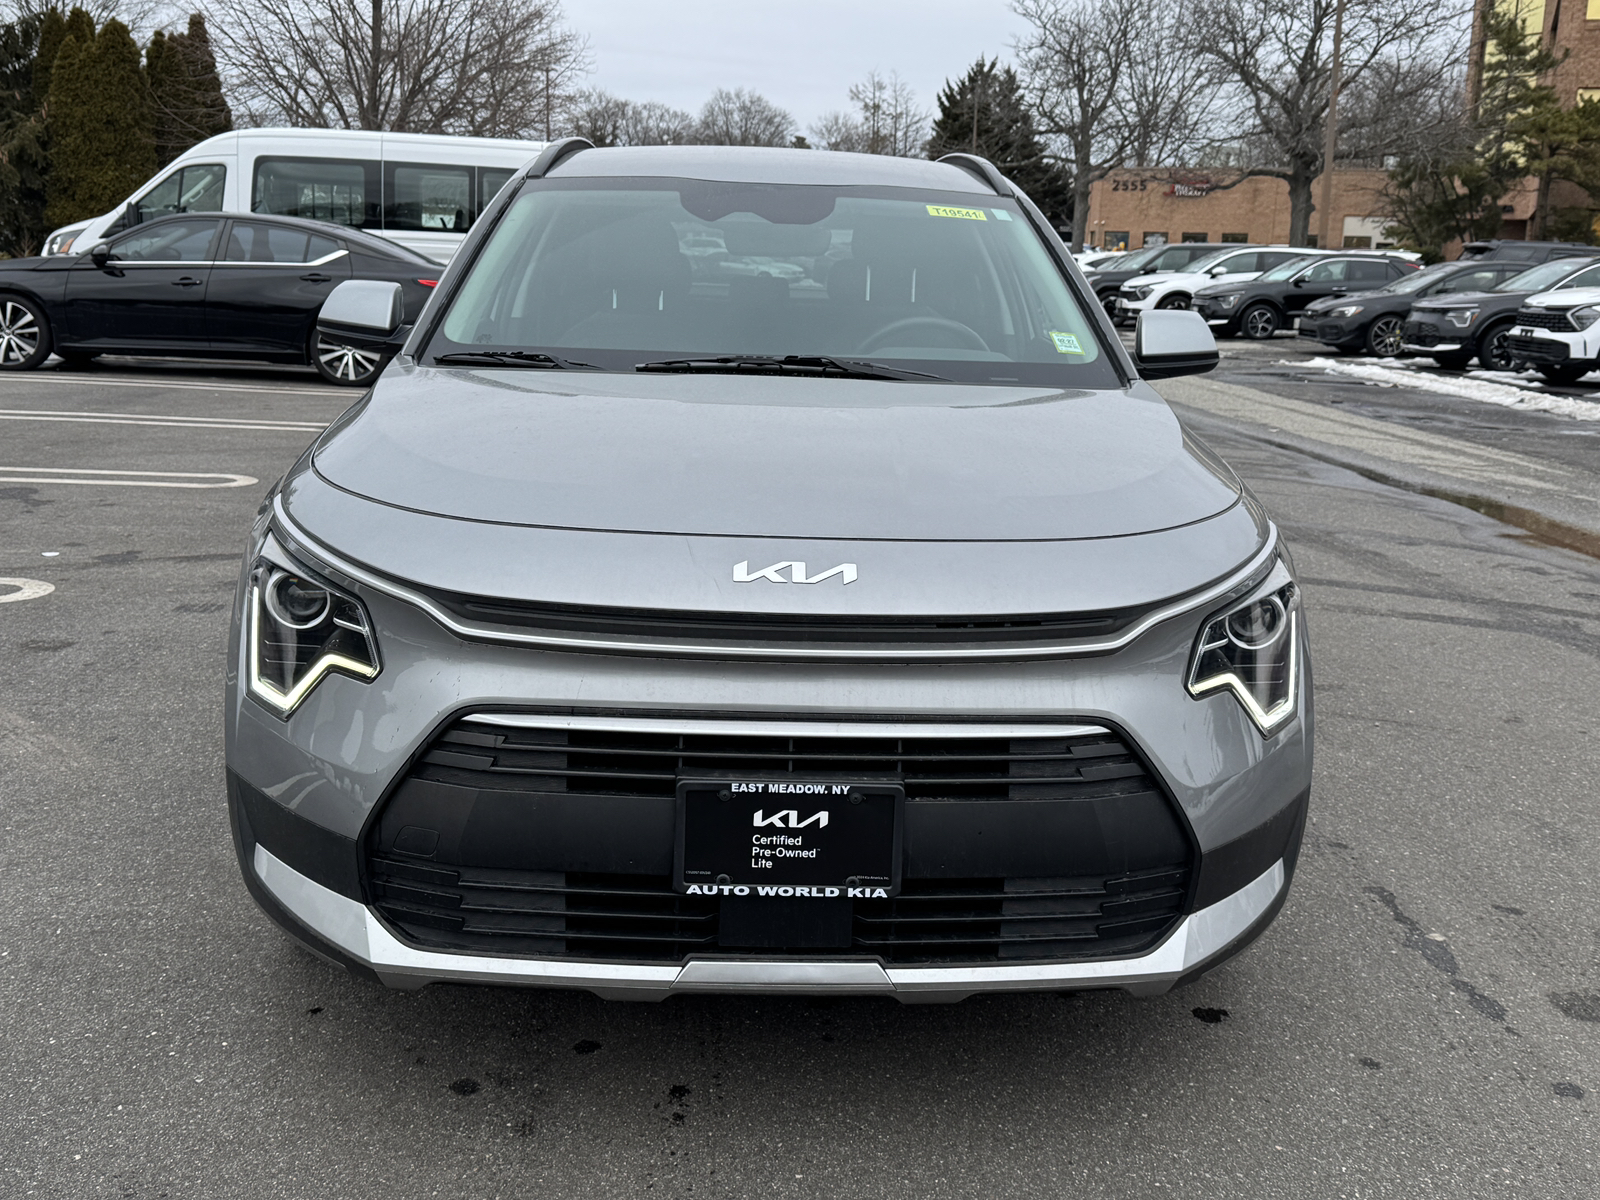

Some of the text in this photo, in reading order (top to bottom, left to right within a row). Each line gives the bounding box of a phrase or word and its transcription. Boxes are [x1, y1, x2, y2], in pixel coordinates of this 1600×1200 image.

[1111, 178, 1148, 192] 2555
[932, 207, 979, 219] T19541
[732, 560, 858, 586] KIA
[731, 783, 764, 793] EAST
[832, 785, 850, 795] NY
[753, 809, 829, 829] KIA
[752, 834, 802, 846] Certified
[751, 858, 773, 869] Lite
[686, 885, 888, 898] AUTO WORLD KIA
